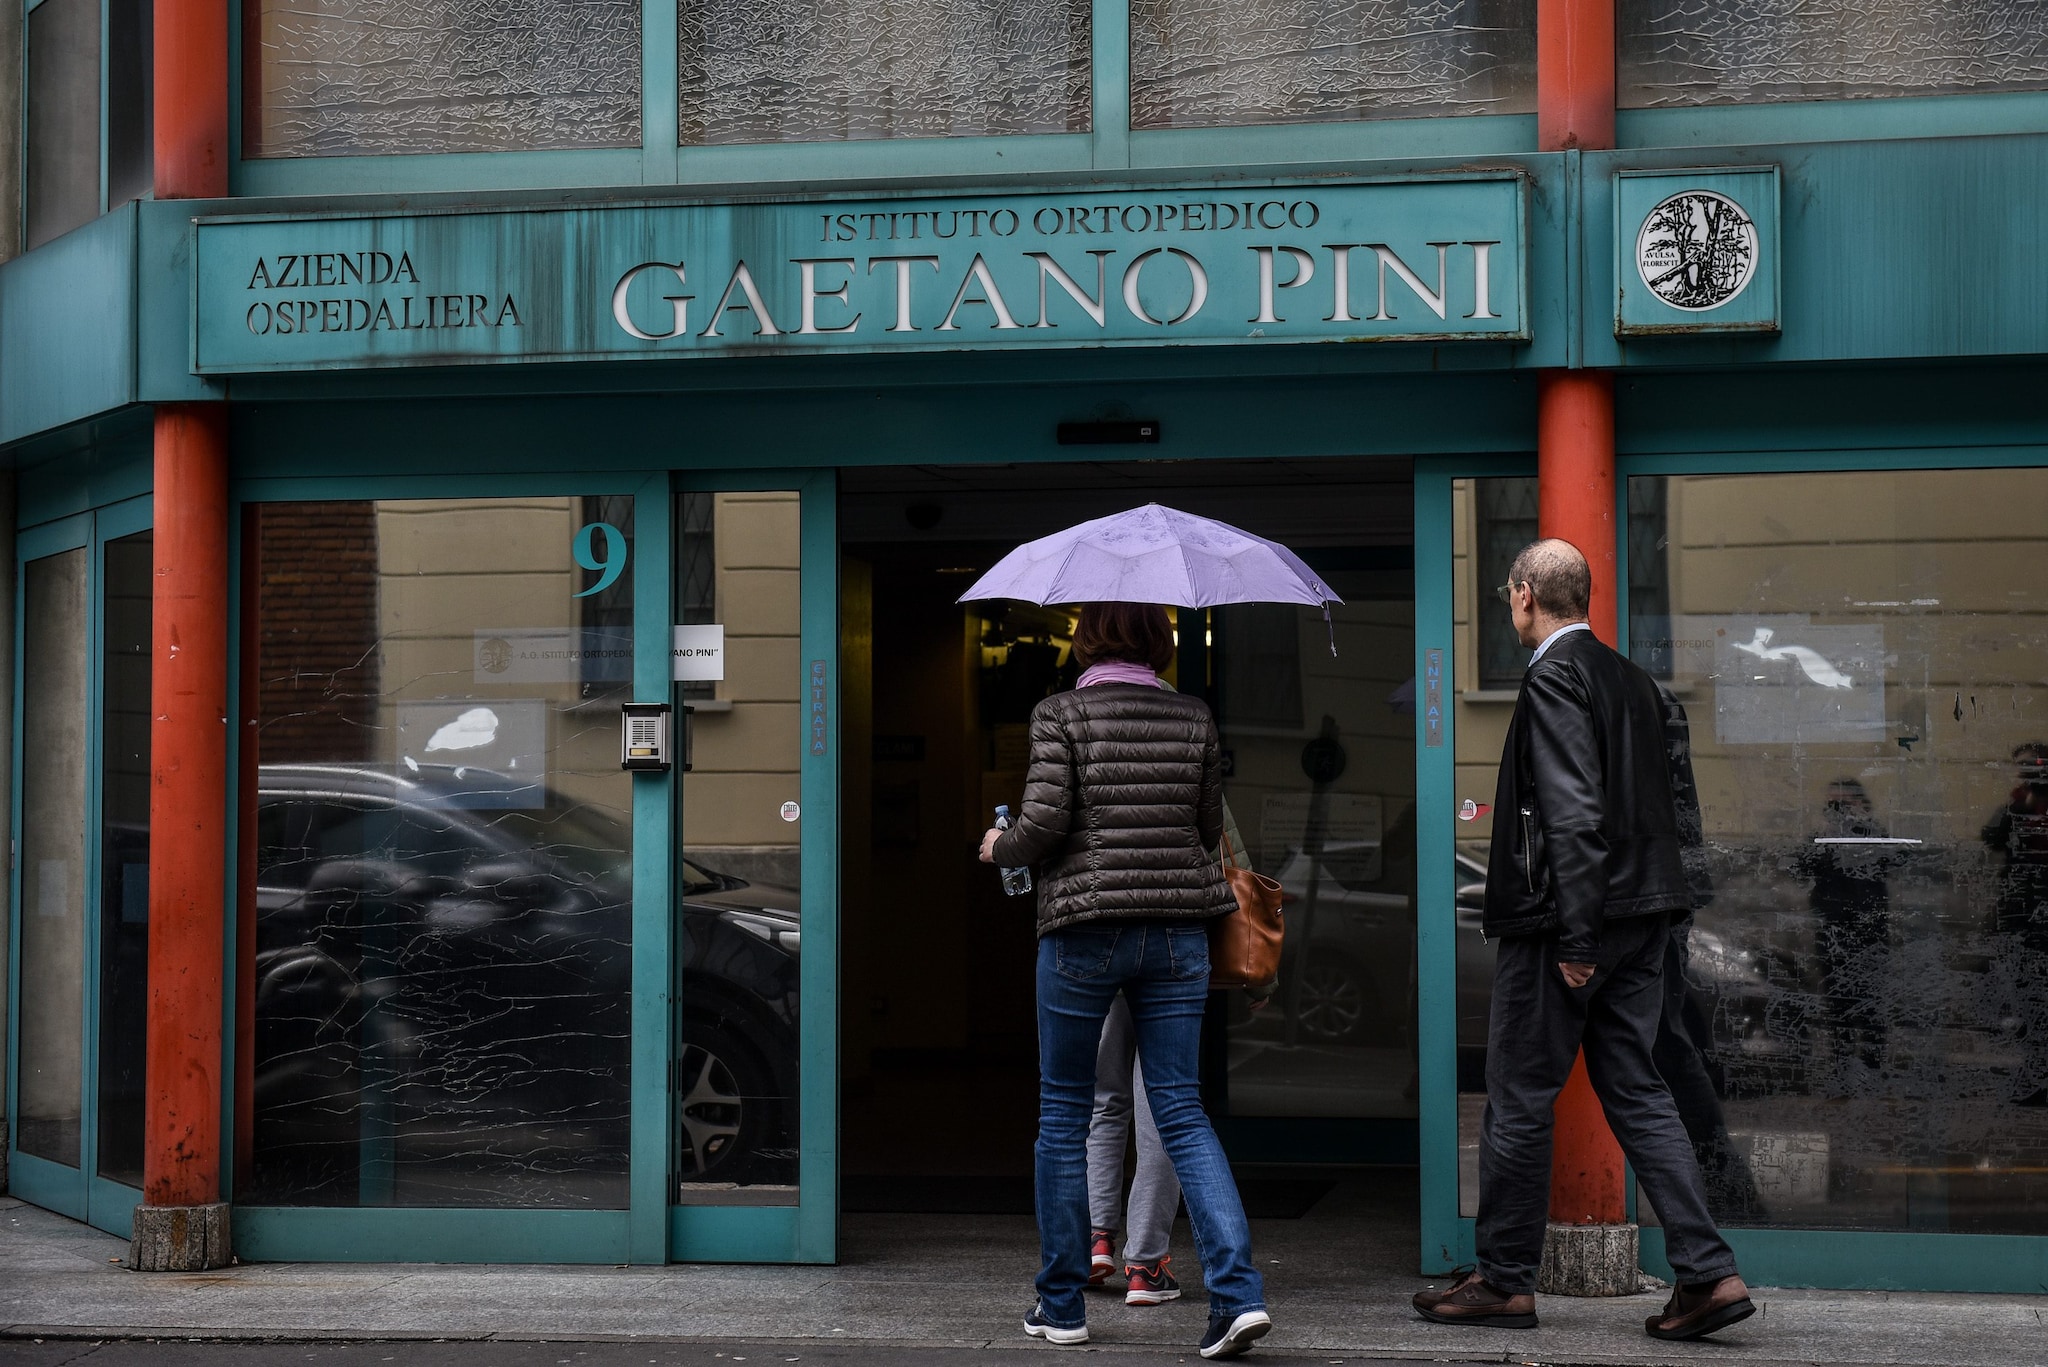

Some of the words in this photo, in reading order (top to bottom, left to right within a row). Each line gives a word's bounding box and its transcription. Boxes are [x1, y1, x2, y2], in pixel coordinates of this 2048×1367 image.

[820, 208, 1020, 242] ISTITUTO
[1033, 201, 1320, 235] ORTOPEDICO
[247, 250, 420, 289] AZIENDA
[1642, 259, 1680, 267] FLORESCIT
[1644, 251, 1676, 259] AVULSA
[611, 247, 1208, 341] GAETANO
[1247, 240, 1501, 323] PINI
[246, 293, 524, 335] OSPEDALIERA
[572, 522, 627, 598] 9
[542, 650, 580, 660] ISTITUTO
[583, 649, 634, 659] ORTOPEDIC
[672, 648, 693, 657] ANO
[813, 663, 824, 750] ENTRATA
[1428, 653, 1440, 730] ENTRAT
